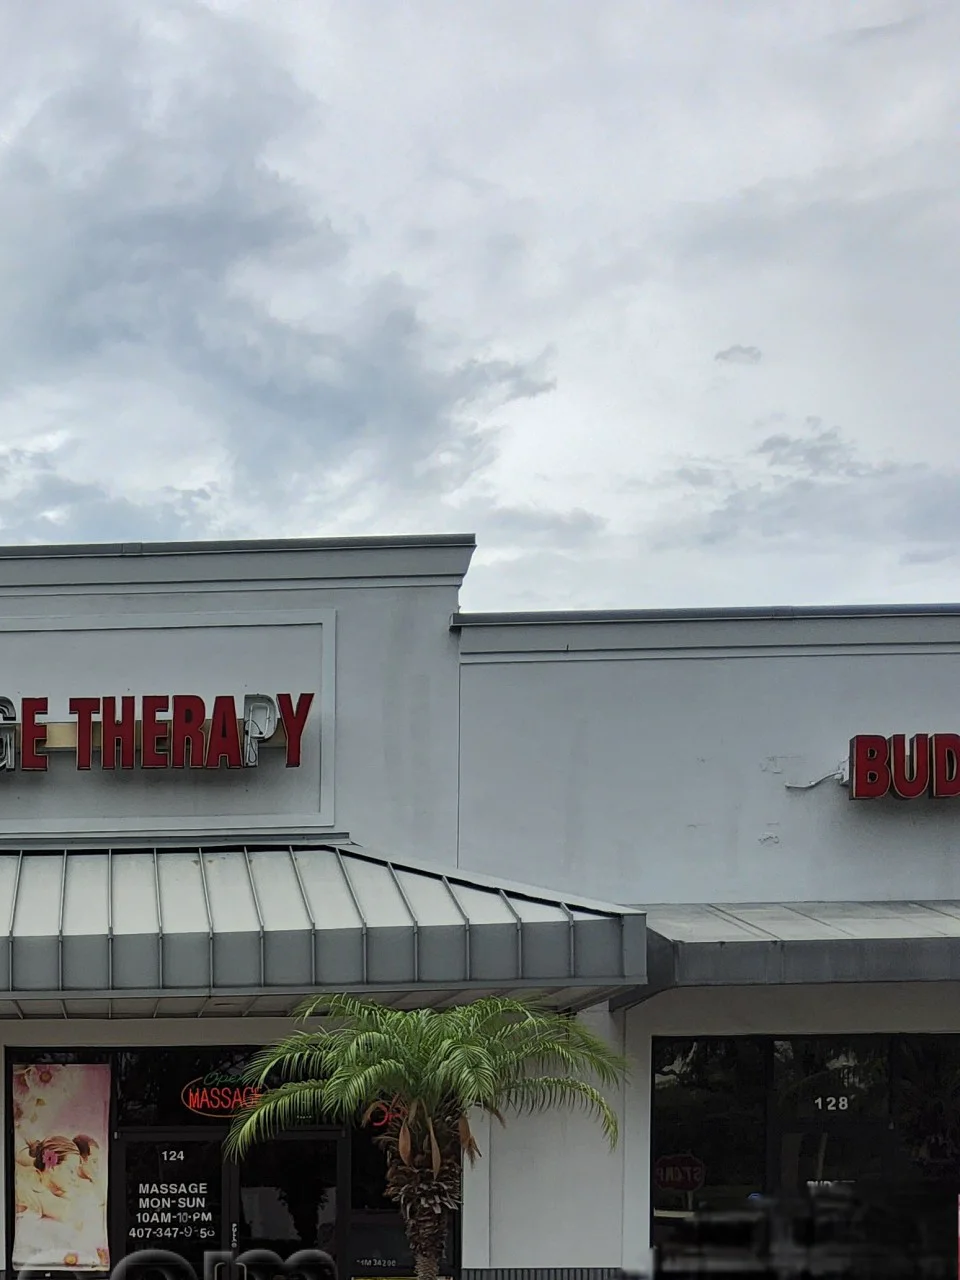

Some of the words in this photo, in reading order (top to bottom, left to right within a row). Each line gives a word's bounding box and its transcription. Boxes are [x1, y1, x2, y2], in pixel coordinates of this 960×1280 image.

[69, 693, 315, 771] THERAPY
[849, 733, 960, 800] BUD
[814, 1096, 849, 1111] 128
[161, 1150, 185, 1162] 124
[138, 1182, 208, 1195] MASSAGE
